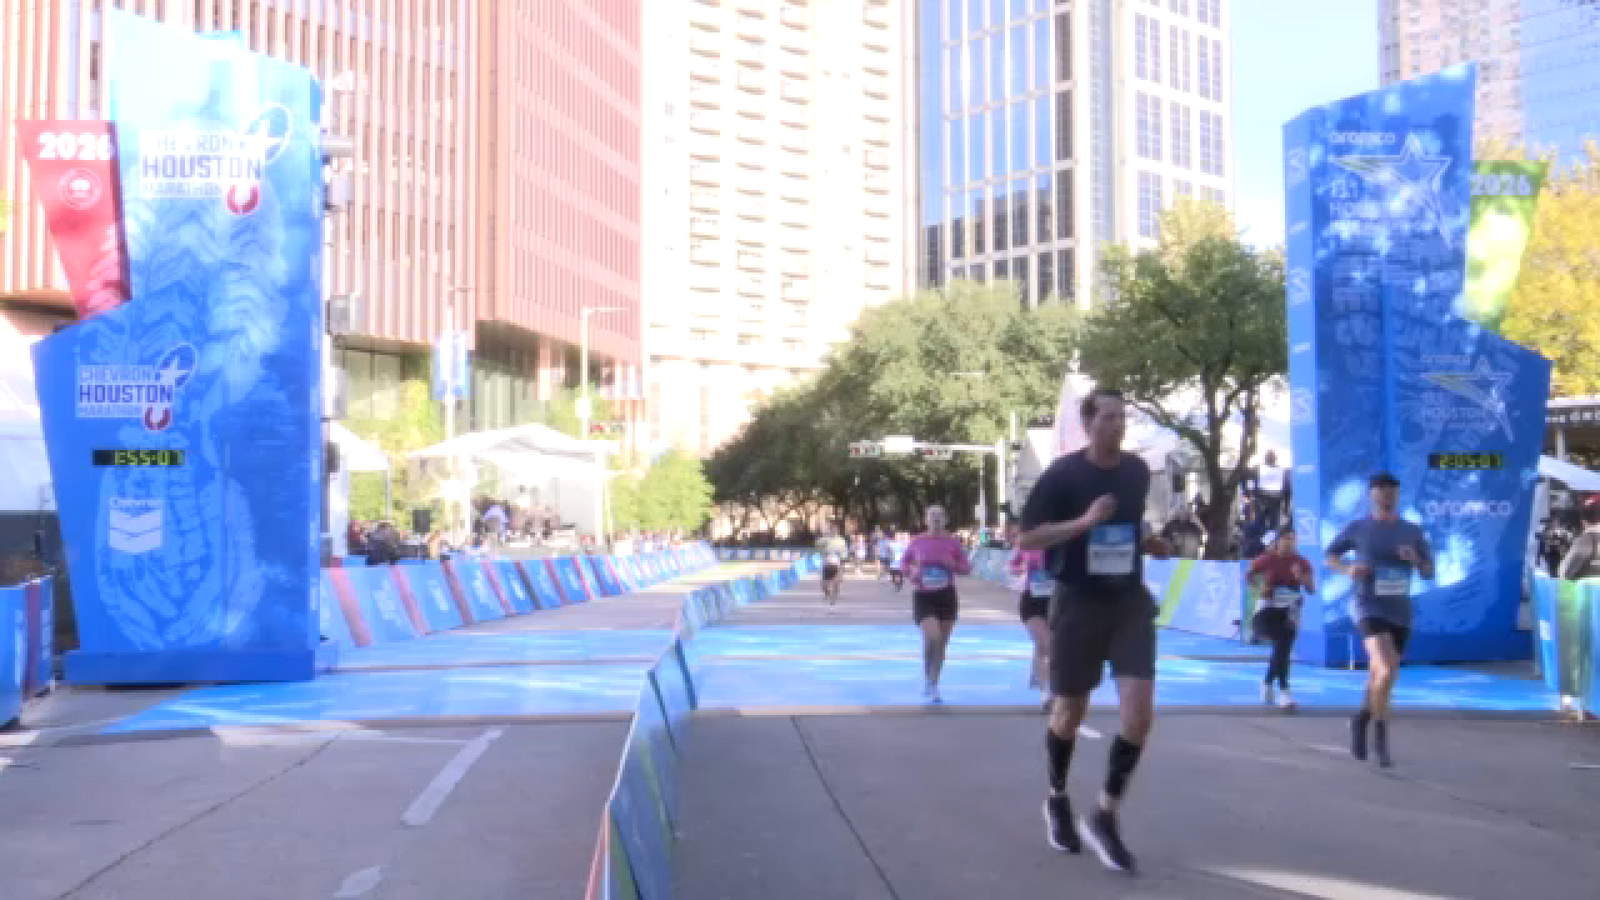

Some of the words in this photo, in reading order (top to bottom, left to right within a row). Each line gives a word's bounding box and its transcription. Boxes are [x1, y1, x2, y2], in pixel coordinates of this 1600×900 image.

[142, 155, 261, 180] HOUSTON
[1470, 174, 1531, 196] 2026
[79, 385, 172, 403] HOUSTON
